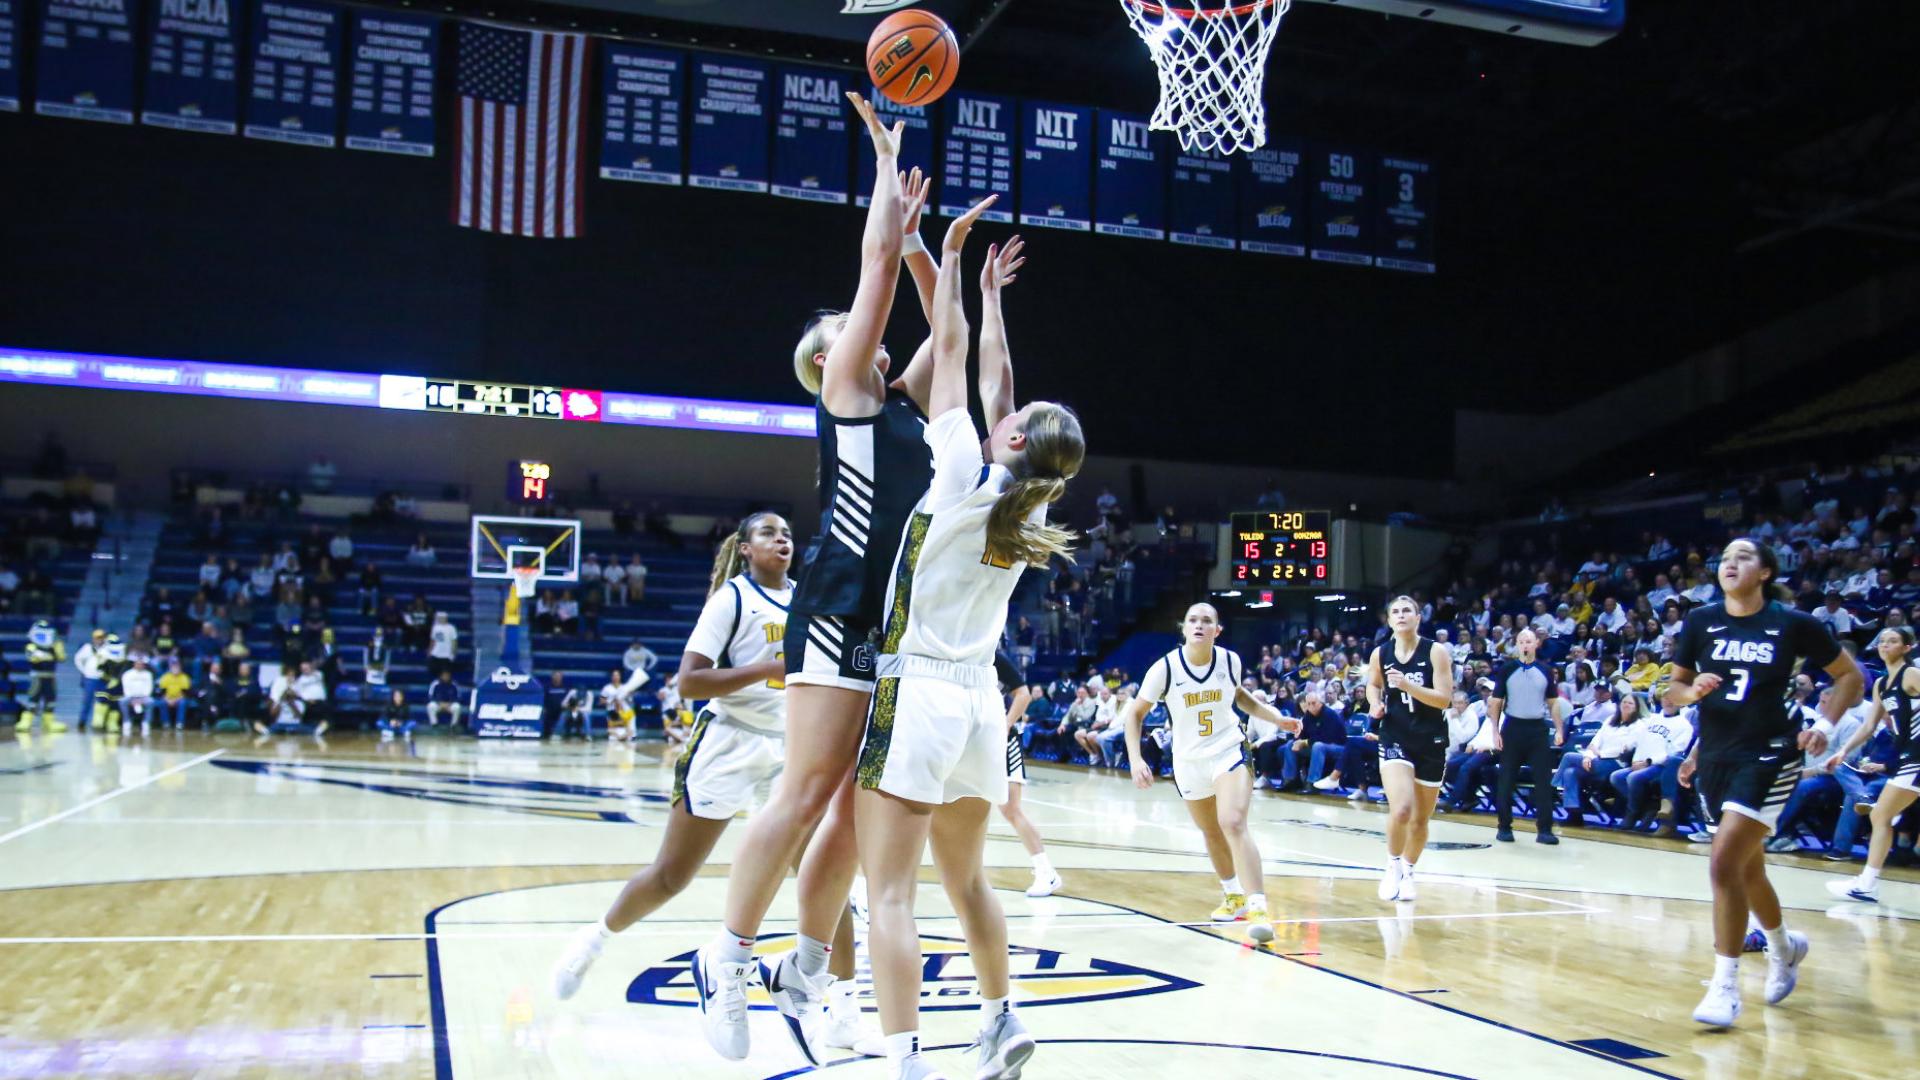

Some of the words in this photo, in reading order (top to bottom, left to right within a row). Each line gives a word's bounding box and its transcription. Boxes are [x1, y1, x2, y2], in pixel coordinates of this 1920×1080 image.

[161, 0, 228, 24] NCAA
[874, 35, 915, 79] ELITE
[785, 74, 840, 105] NCAA
[958, 98, 1001, 129] NIT
[1036, 108, 1079, 140] NIT
[952, 126, 1006, 142] APPEARANCES
[1067, 140, 1078, 151] UP
[1111, 118, 1151, 150] NIT
[1109, 146, 1154, 161] SEMIFINALS
[1252, 161, 1294, 177] NICHOLS
[1329, 153, 1354, 178] 50
[1399, 173, 1414, 202] 3
[1256, 213, 1291, 228] TOLEDO
[523, 477, 544, 500] 14
[1269, 512, 1303, 530] 7:20
[1240, 532, 1264, 541] TOLEDO
[1293, 531, 1322, 540] GONZAGA
[1245, 542, 1260, 559] 15
[1275, 543, 1284, 557] 2
[1311, 541, 1326, 558] 13
[1238, 564, 1247, 579] 2
[1316, 564, 1325, 579] 0
[852, 645, 872, 672] G
[1711, 639, 1775, 664] ZAGS
[1725, 668, 1749, 701] 3
[1183, 689, 1222, 708] TOLEDO
[1400, 691, 1414, 713] 4
[1198, 710, 1212, 737] 5
